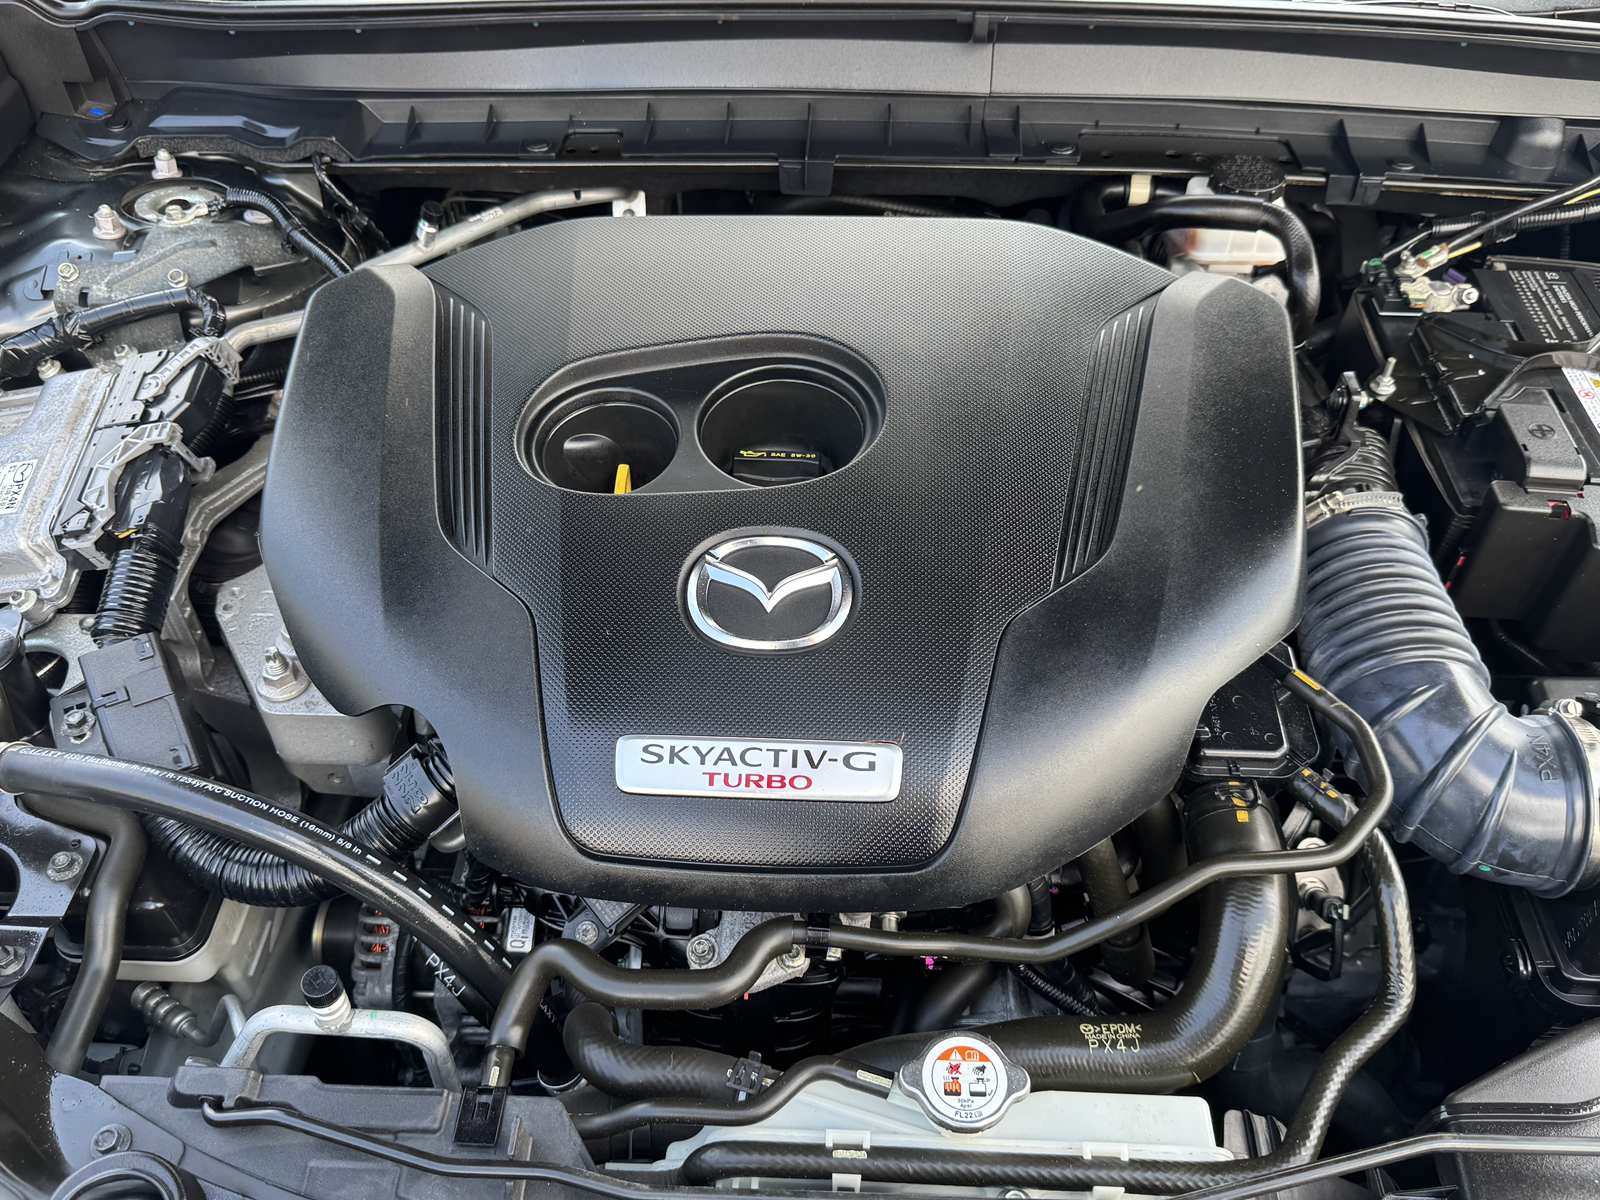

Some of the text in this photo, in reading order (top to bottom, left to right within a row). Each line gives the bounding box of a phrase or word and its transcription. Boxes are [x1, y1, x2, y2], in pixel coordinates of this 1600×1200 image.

[640, 743, 877, 772] SKYACTIV-G
[1526, 733, 1559, 782] PX4N
[19, 747, 65, 759] GALAXY
[205, 783, 223, 795] A/C
[224, 788, 270, 811] SUCTION
[270, 806, 300, 824] HOSE
[300, 820, 336, 842] (16mm)
[702, 771, 813, 791] TURBO
[425, 952, 466, 997] PX4J
[540, 999, 558, 1023] LAXY
[954, 1110, 973, 1119] FL22
